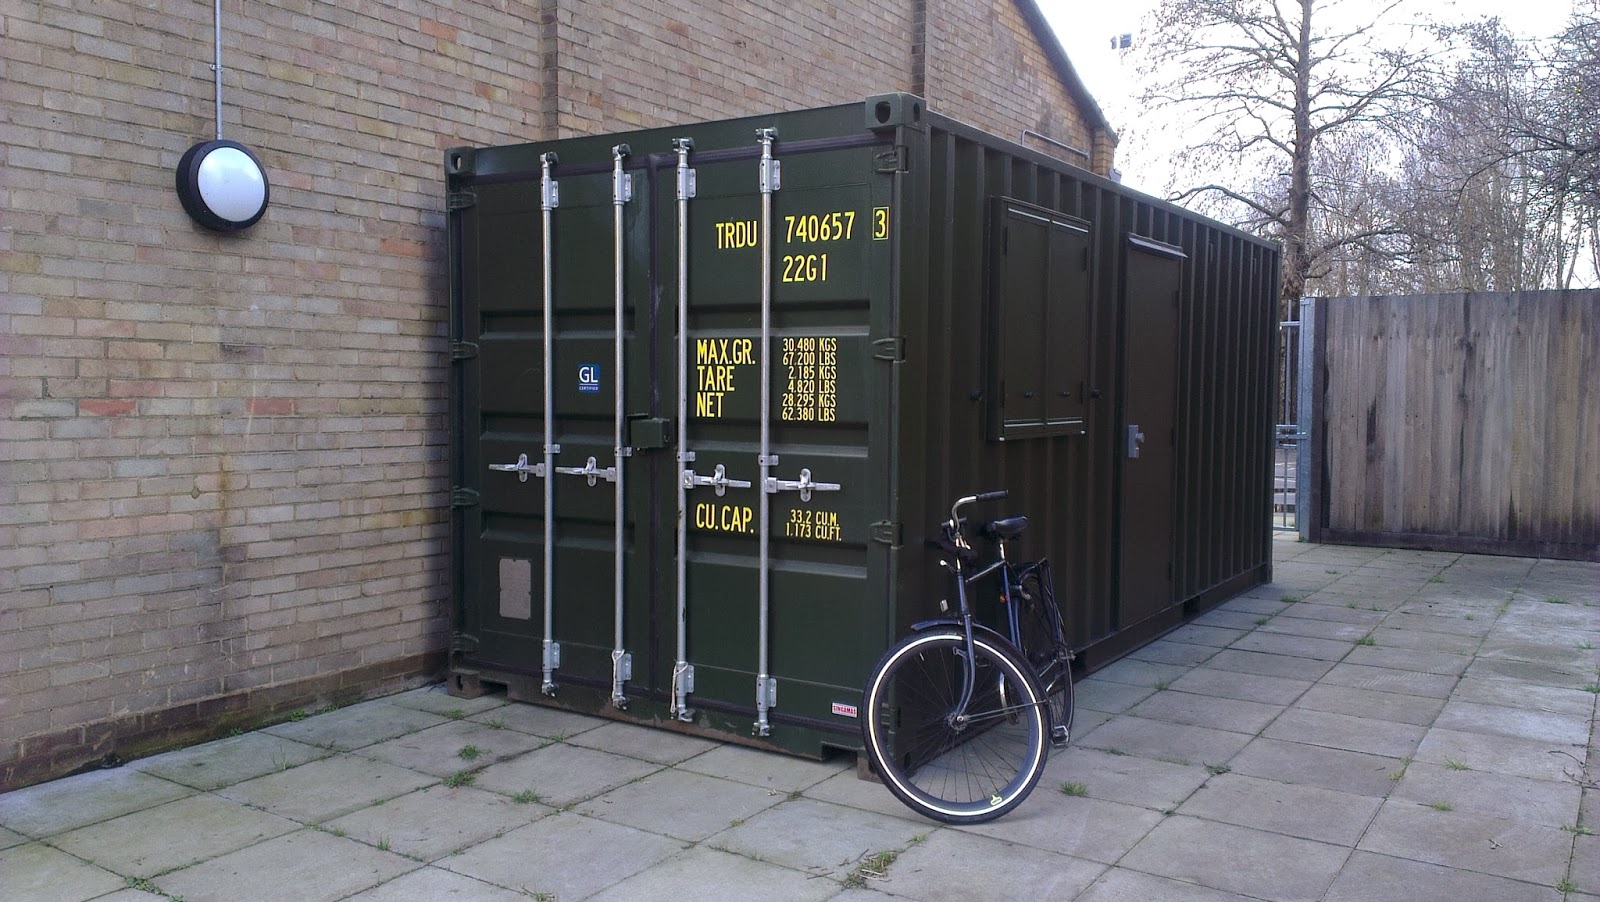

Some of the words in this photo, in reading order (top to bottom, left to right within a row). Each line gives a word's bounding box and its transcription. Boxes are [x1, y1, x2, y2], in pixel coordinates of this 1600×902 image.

[716, 220, 757, 249] TRDU
[785, 211, 855, 243] 740657
[875, 209, 887, 238] 3
[782, 254, 828, 283] 22G1
[697, 338, 756, 365] MAX.GR.
[783, 338, 815, 352] 30.480
[818, 338, 837, 352] KGS
[782, 352, 815, 366] 67.200
[818, 352, 837, 366] LBS
[579, 366, 598, 383] GL
[697, 365, 735, 391] TARE
[788, 366, 815, 380] 2.185
[818, 366, 837, 380] KGS
[787, 380, 815, 394] 4.820
[818, 380, 836, 394] LBS
[696, 392, 724, 418] NET
[782, 393, 814, 407] 28.295
[818, 393, 836, 407] KGS
[782, 407, 814, 421] 62.380
[818, 408, 836, 422] LBS
[696, 503, 754, 533] CU.CAP.
[790, 509, 812, 525] 33.2
[815, 511, 839, 526] CU.M.
[786, 522, 812, 538] 1.173
[815, 525, 842, 541] CU.FT.
